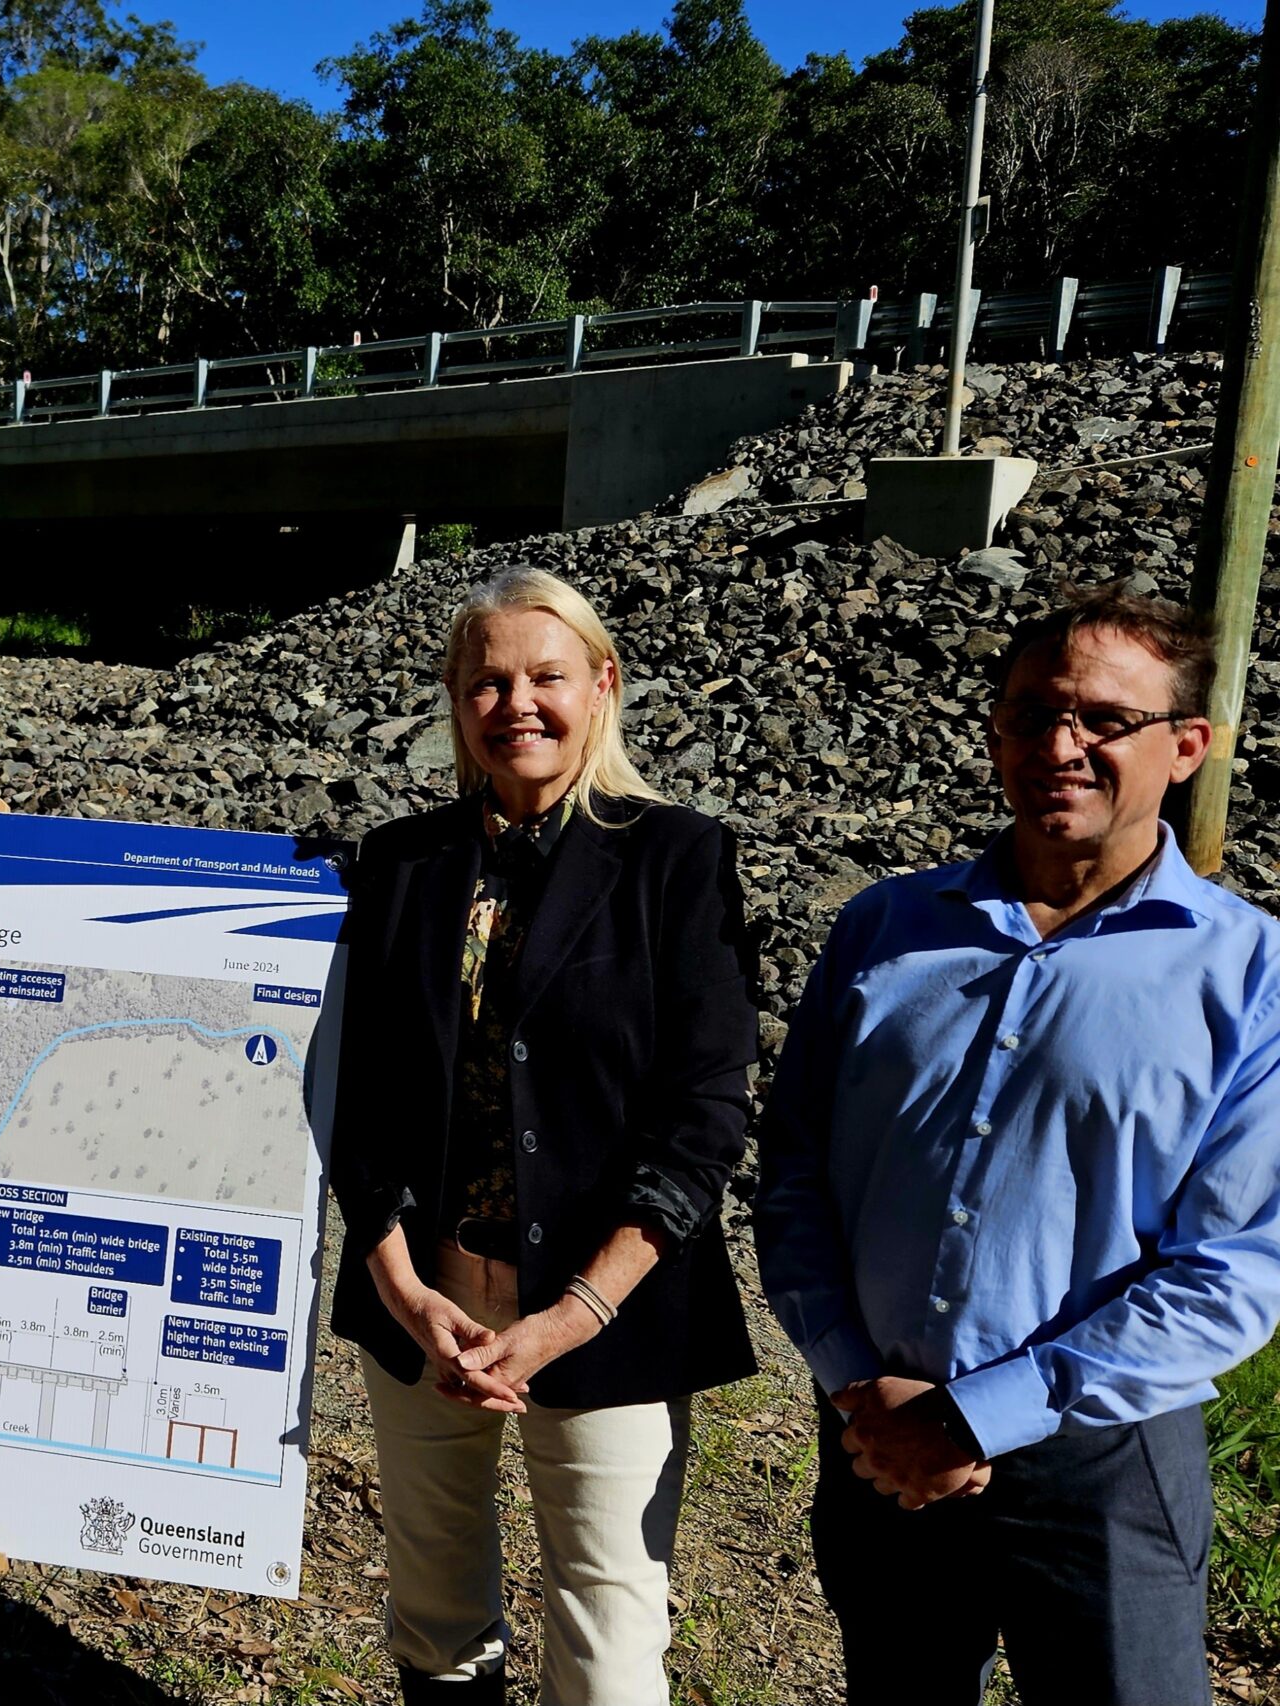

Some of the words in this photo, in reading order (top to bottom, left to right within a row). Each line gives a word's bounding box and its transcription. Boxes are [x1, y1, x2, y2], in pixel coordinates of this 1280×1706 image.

[123, 852, 180, 866] Department
[182, 857, 193, 866] of
[194, 857, 239, 871] Transport
[240, 862, 260, 872] and
[262, 863, 287, 874] Main
[289, 866, 320, 878] Roads
[223, 958, 250, 971] June
[252, 961, 279, 973] 2024
[20, 974, 63, 987] accesses
[8, 985, 56, 998] reinstated
[256, 987, 281, 999] Final
[283, 990, 317, 1004] design
[21, 1189, 64, 1204] SECTION
[13, 1209, 44, 1224] bridge
[11, 1223, 36, 1236] Total
[39, 1229, 68, 1240] 12.6m
[71, 1230, 97, 1245] (min)
[100, 1235, 125, 1247] wide
[127, 1237, 160, 1253] bridge
[180, 1229, 219, 1246] Existing
[222, 1234, 255, 1250] bridge
[9, 1239, 34, 1250] 3.8m
[37, 1241, 63, 1255] (min)
[66, 1244, 97, 1259] Traffic
[99, 1248, 126, 1262] lanes
[203, 1246, 229, 1260] Total
[232, 1252, 258, 1263] 5.5m
[7, 1254, 32, 1266] 2.5m
[35, 1256, 61, 1270] (min)
[64, 1259, 114, 1275] Shoulders
[202, 1262, 227, 1274] wide
[230, 1264, 263, 1280] bridge
[200, 1277, 226, 1289] 3.5m
[229, 1279, 261, 1294] Single
[91, 1287, 123, 1302] Bridge
[199, 1290, 229, 1303] traffic
[232, 1293, 254, 1306] lane
[89, 1301, 123, 1315] barrier
[20, 1320, 46, 1332] 3.8m
[63, 1326, 89, 1338] 3.8m
[168, 1316, 191, 1328] New
[193, 1319, 226, 1334] bridge
[229, 1326, 243, 1337] up
[246, 1327, 258, 1337] to
[260, 1328, 288, 1342] 3.0m
[98, 1330, 124, 1343] 2.5m
[167, 1330, 200, 1344] higher
[202, 1335, 225, 1347] than
[229, 1339, 269, 1356] existing
[98, 1344, 126, 1358] (min)
[165, 1345, 199, 1359] timber
[202, 1349, 236, 1365] bridge
[194, 1383, 220, 1395] 3.5m
[156, 1388, 168, 1415] 3.0m
[2, 1420, 30, 1433] Creek
[140, 1516, 245, 1548] Queensland
[138, 1537, 243, 1569] Government
